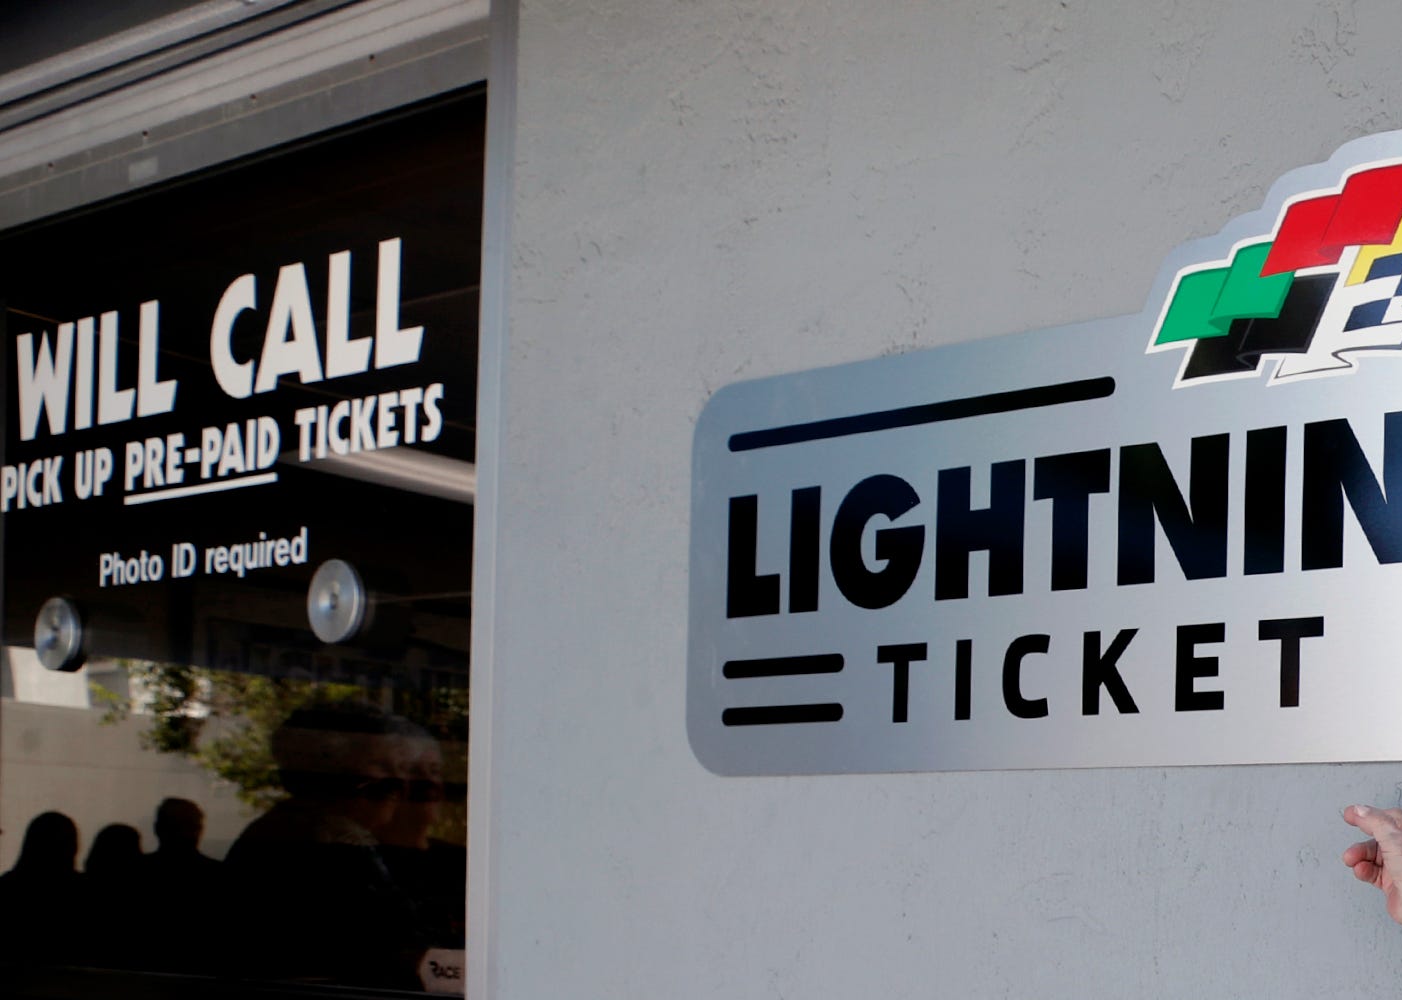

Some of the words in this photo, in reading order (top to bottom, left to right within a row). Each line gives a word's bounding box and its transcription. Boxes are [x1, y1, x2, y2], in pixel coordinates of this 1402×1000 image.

[16, 300, 178, 442] WILL
[210, 237, 424, 399] CALL
[1, 455, 63, 512] PICK
[75, 447, 113, 499] UP
[125, 416, 281, 491] PRE-PAID
[295, 383, 444, 462] TICKETS
[100, 551, 163, 588] Photo
[172, 543, 196, 577] ID
[205, 527, 308, 577] required
[876, 615, 1325, 724] TICKET
